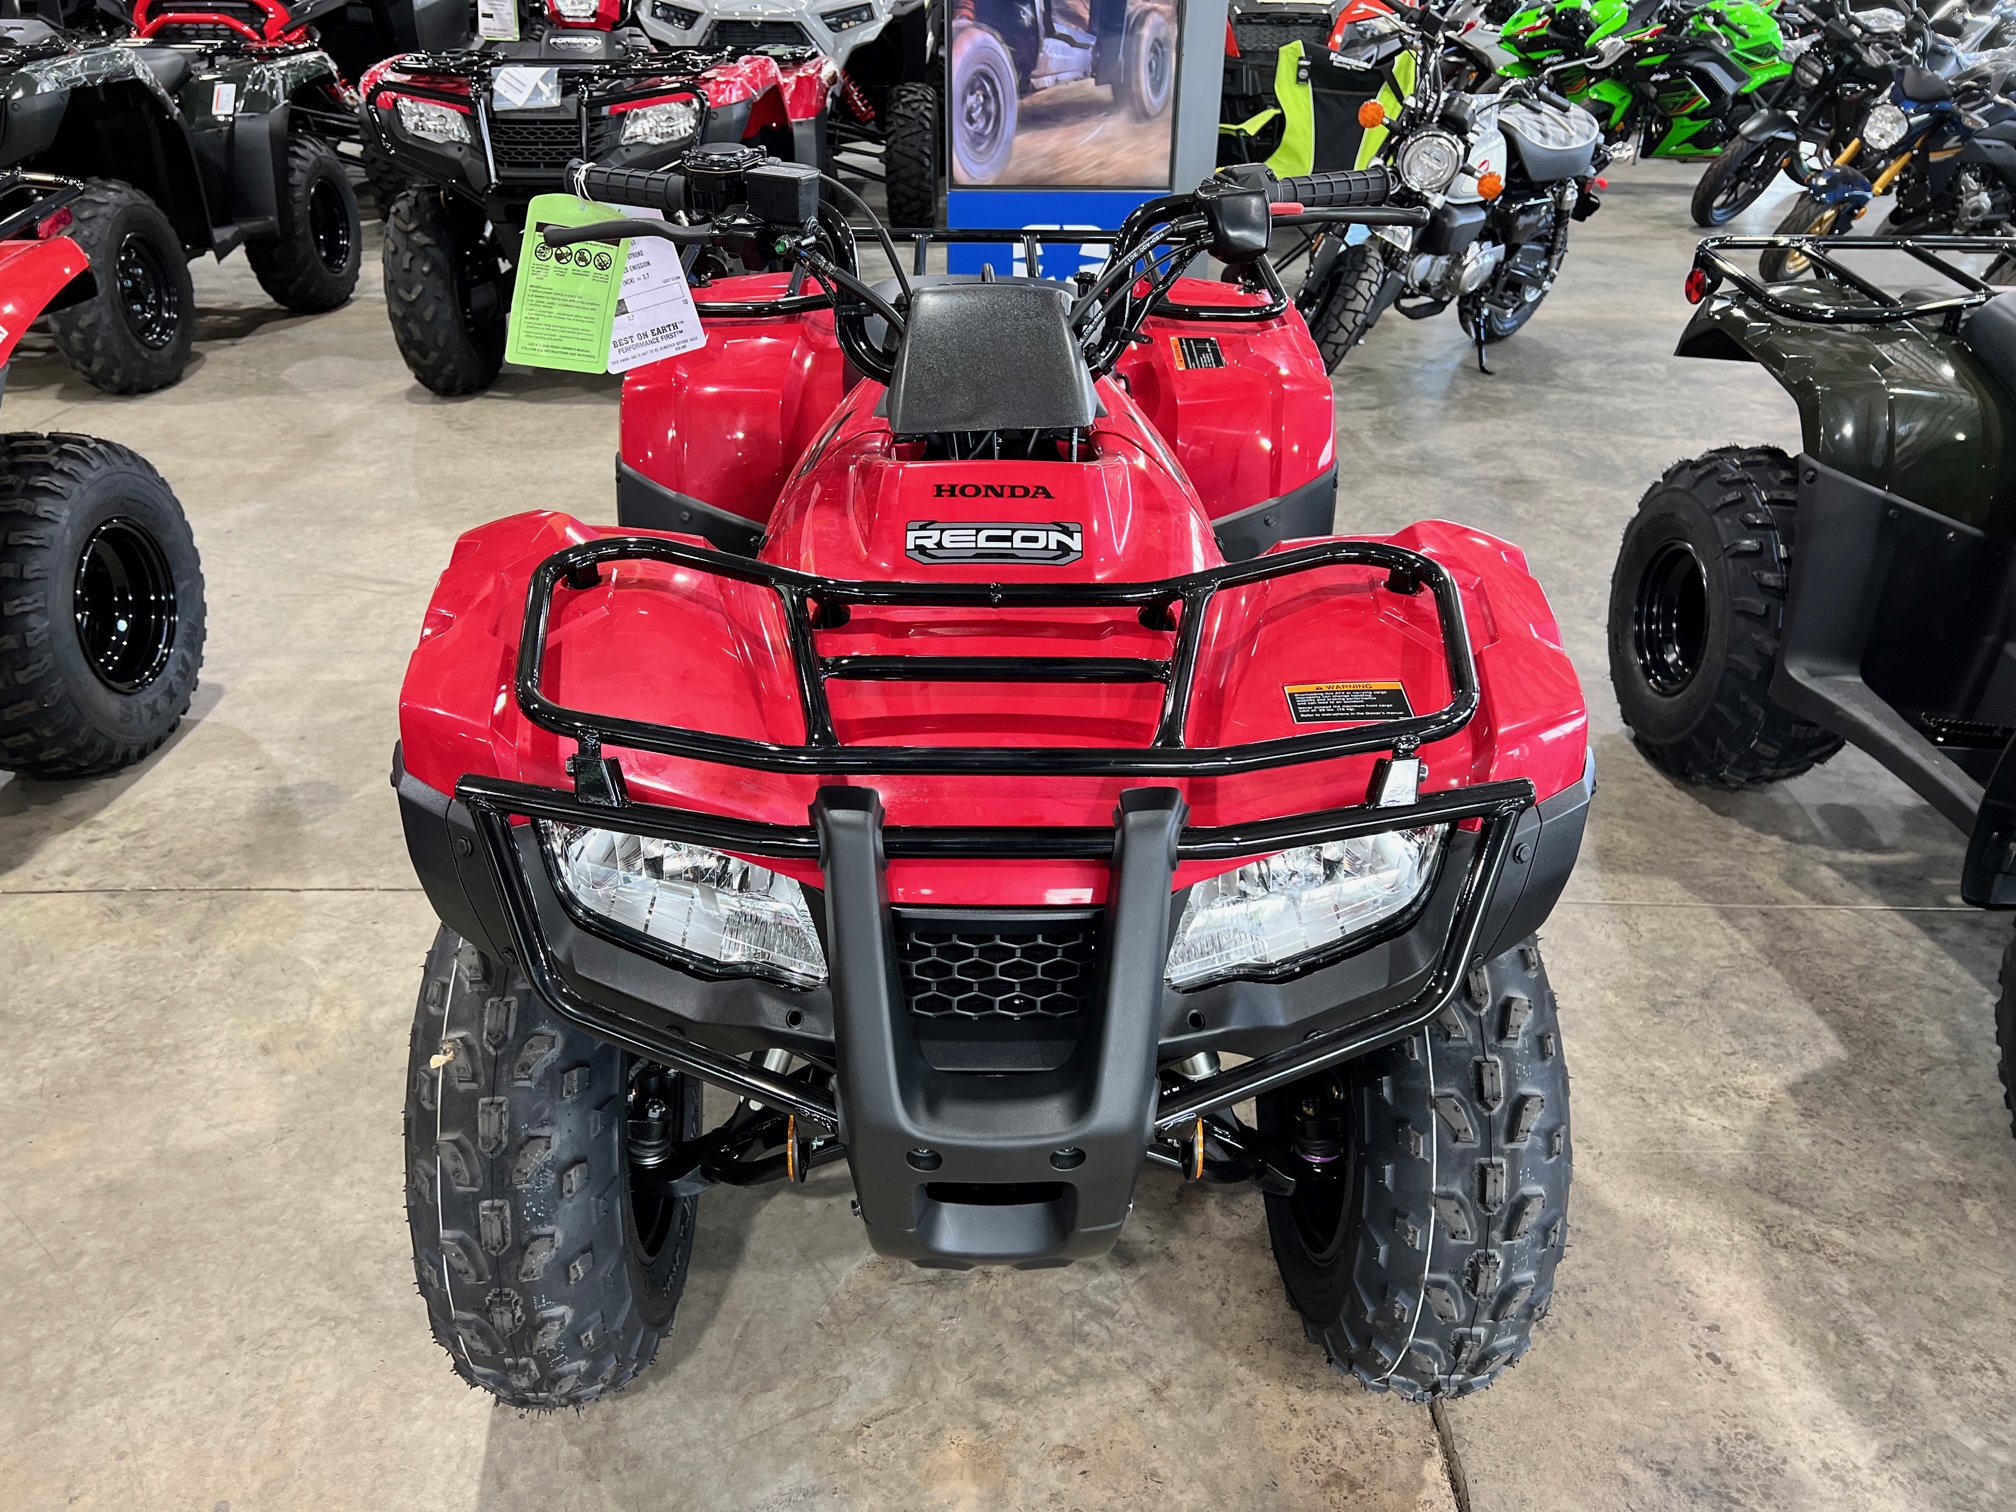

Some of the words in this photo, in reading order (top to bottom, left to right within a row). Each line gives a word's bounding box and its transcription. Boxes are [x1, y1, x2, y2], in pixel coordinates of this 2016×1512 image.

[627, 249, 644, 259] STROKE
[629, 260, 651, 271] EMISSION
[612, 335, 635, 348] BEST
[636, 331, 648, 340] ON
[617, 336, 660, 354] PERFORMANCE
[933, 484, 1055, 499] HONDA
[906, 529, 1082, 551] RECON
